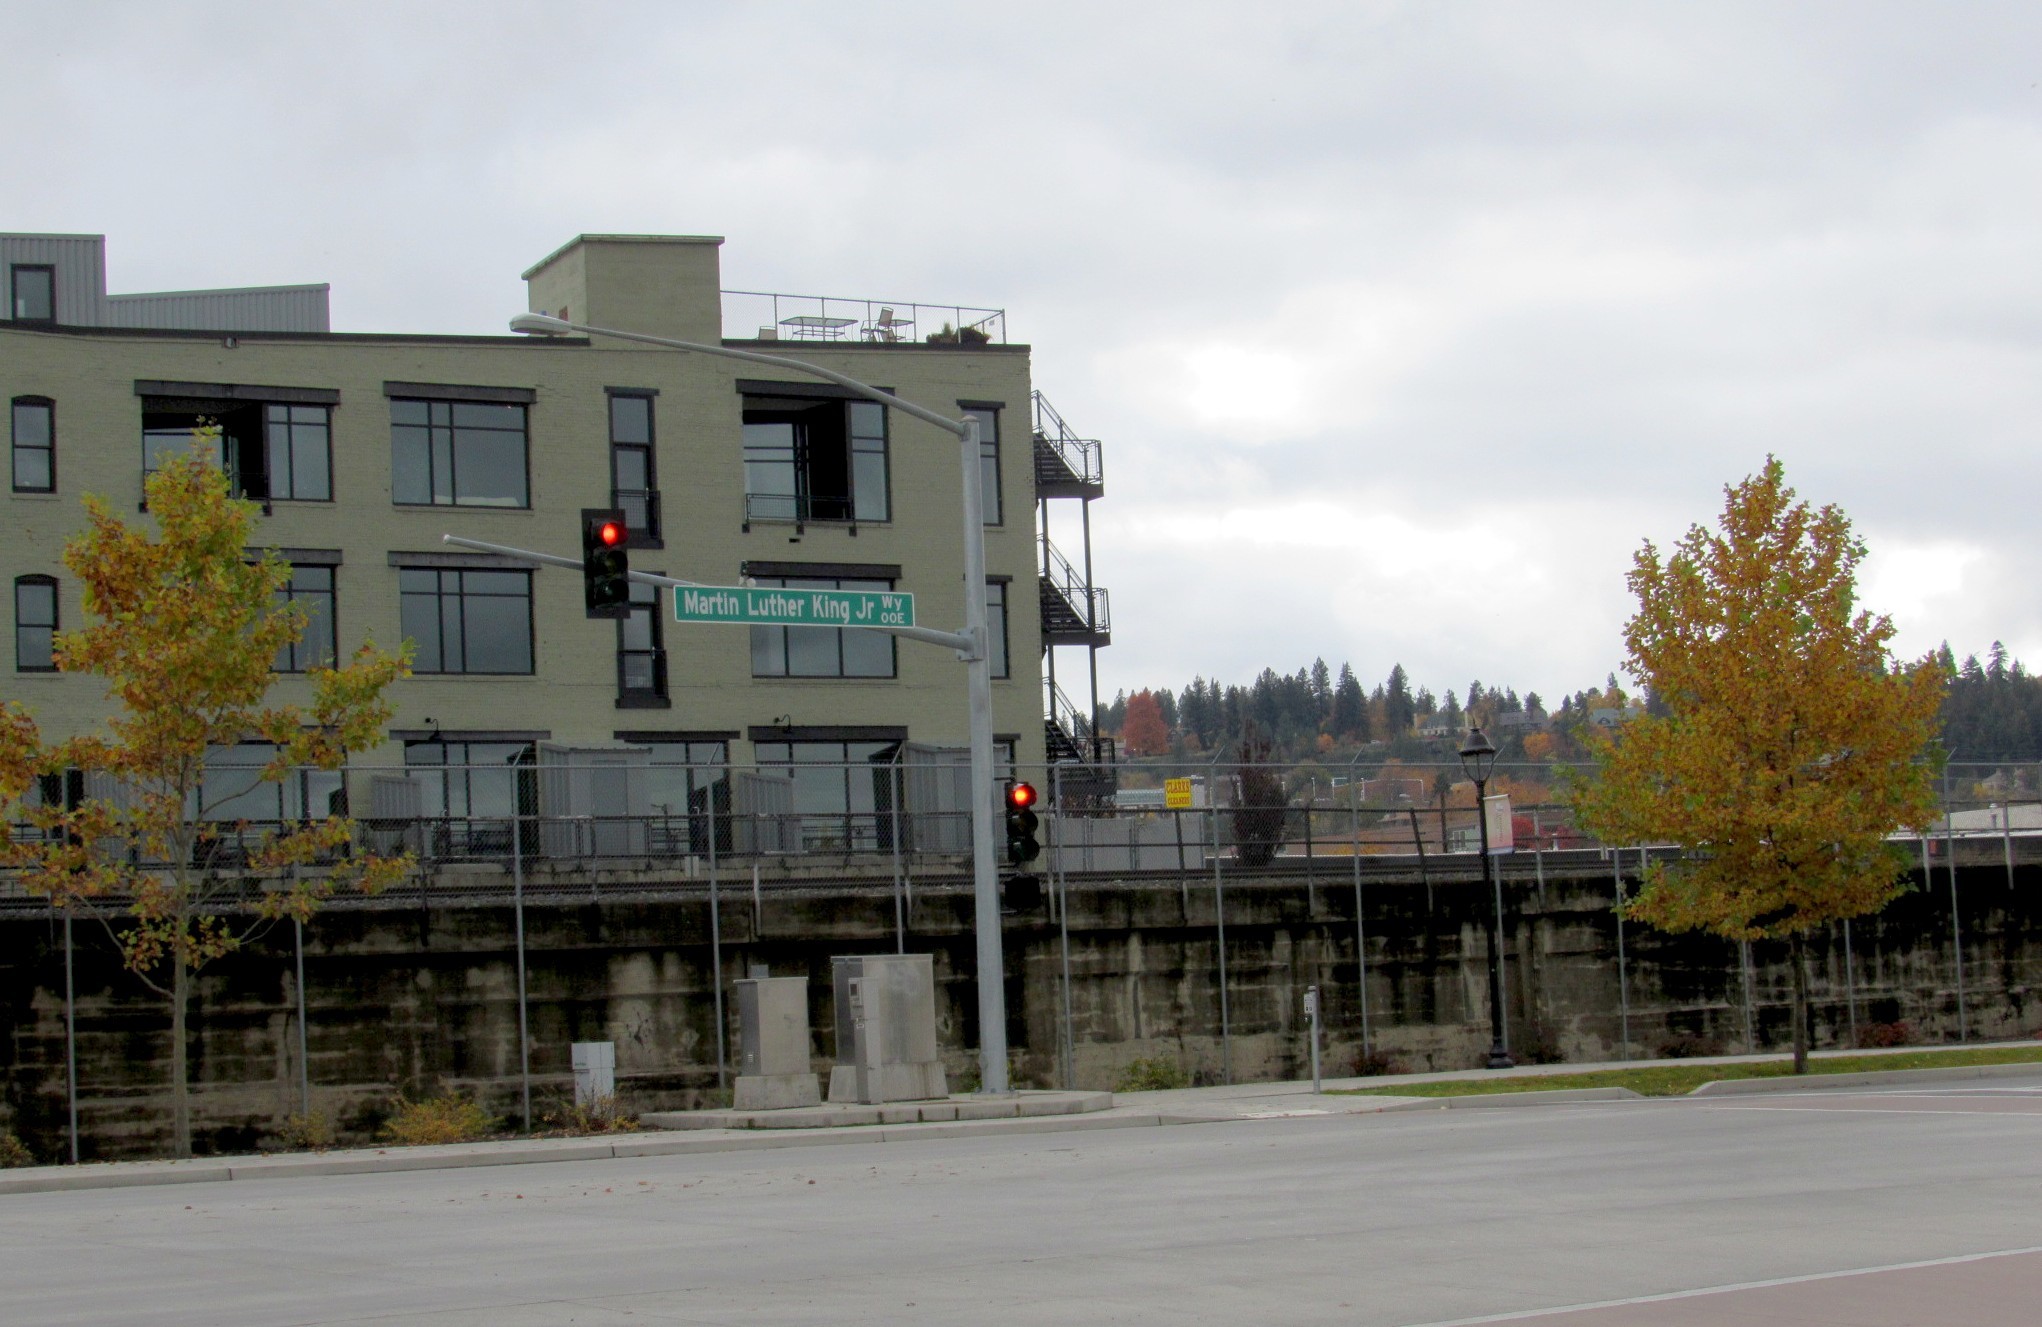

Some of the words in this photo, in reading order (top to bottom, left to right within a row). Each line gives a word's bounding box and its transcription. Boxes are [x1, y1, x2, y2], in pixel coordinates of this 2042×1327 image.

[684, 590, 739, 616] Martin
[748, 592, 804, 618] Luther
[812, 595, 850, 623] King
[856, 597, 874, 619] Jr
[881, 595, 902, 611] Wy
